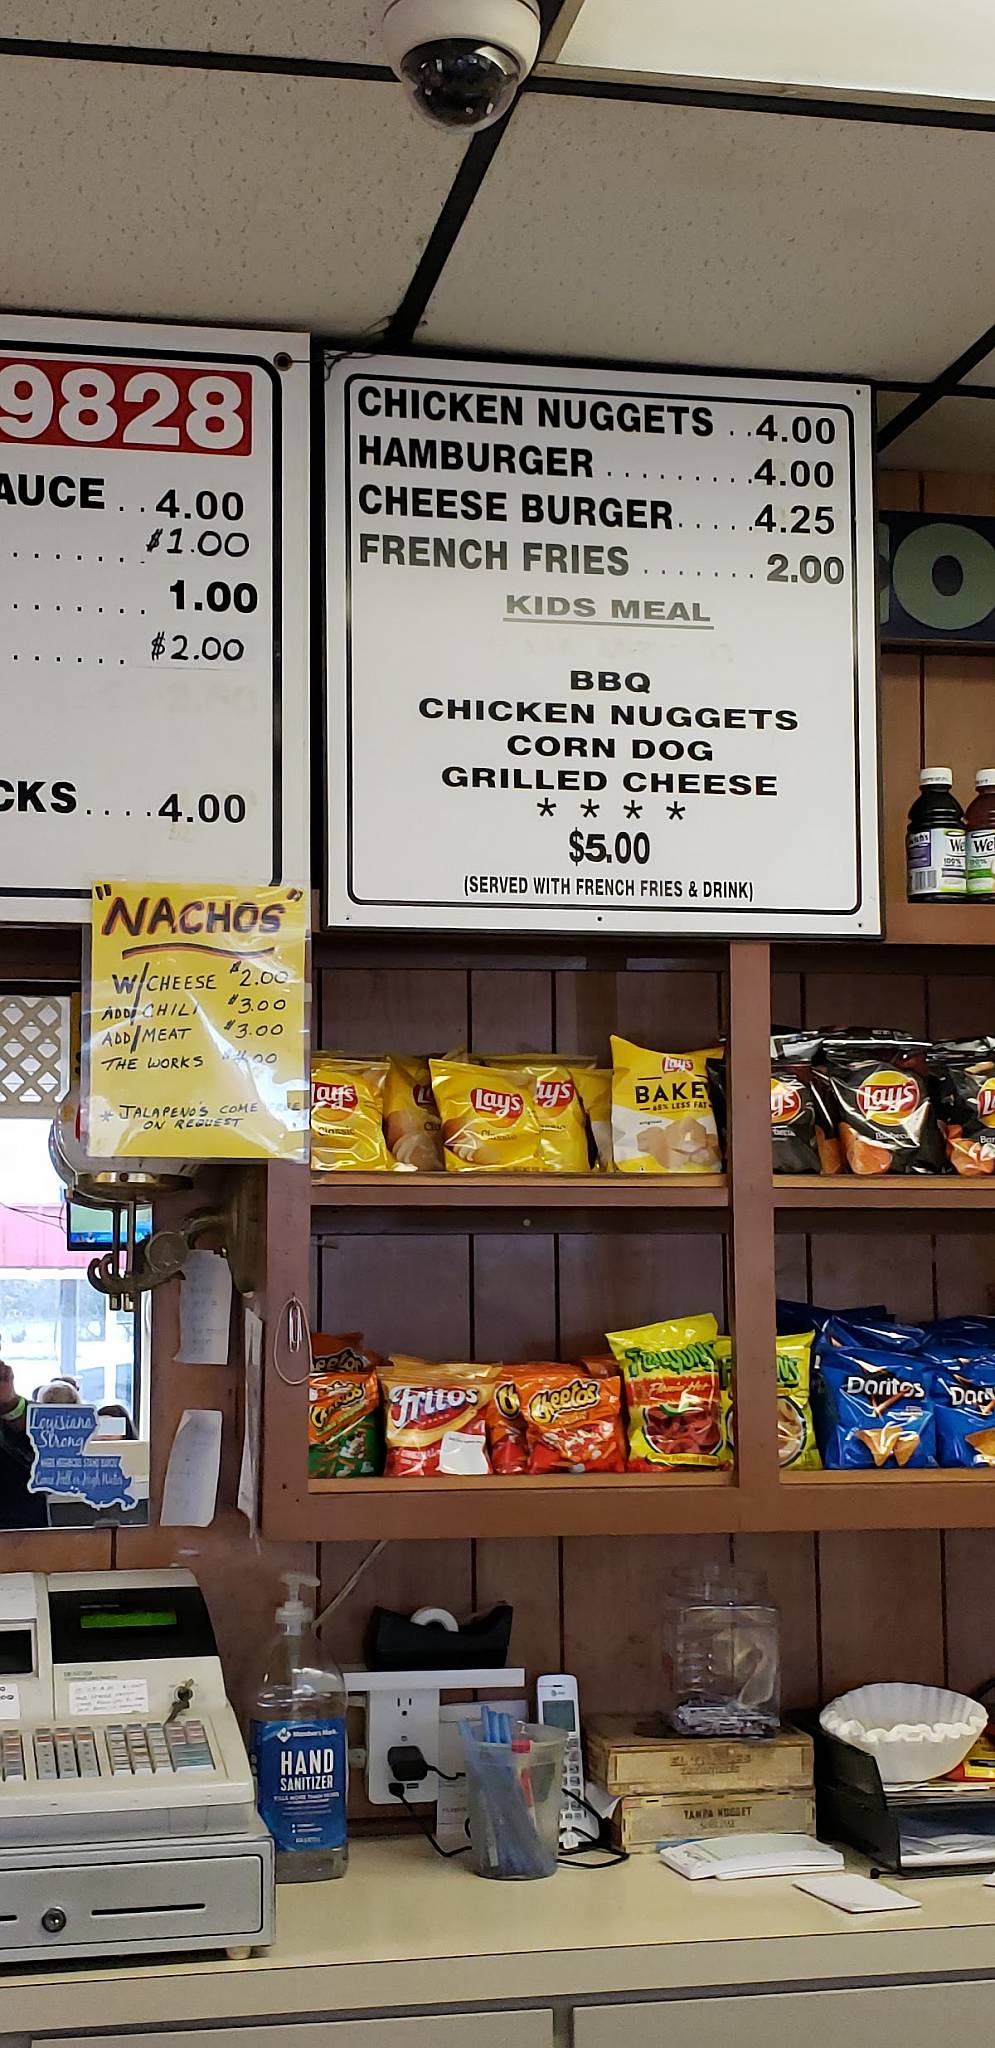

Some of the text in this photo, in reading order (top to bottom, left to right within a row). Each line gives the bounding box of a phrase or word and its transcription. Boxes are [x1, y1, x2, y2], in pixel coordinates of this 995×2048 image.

[357, 386, 836, 444] CHICKEN NUGGETS 4.00
[358, 434, 835, 488] HAMBURGER 4.00
[155, 489, 244, 521] 4.00
[358, 484, 835, 535] CHEESE BURGER 4.25
[146, 528, 250, 558] $1.00
[359, 533, 845, 585] FRENCH FRIES 2.00
[169, 579, 258, 614] 1.00
[505, 594, 712, 623] KIDS MEAL
[151, 631, 245, 661] $2.00
[569, 669, 651, 694] BBQ
[418, 697, 799, 731] CHICKEN NUGGETS
[506, 735, 714, 762] CORN DOG
[441, 766, 778, 797] GRILLED CHEESE
[158, 793, 246, 823] 4.00
[568, 827, 651, 867] $5.00
[464, 875, 754, 902] (SERVED WITH FRENCH FRIES & DRINK)
[230, 960, 289, 987] $2.00
[101, 1058, 138, 1071] THE
[147, 1055, 204, 1070] WORKS
[219, 1102, 259, 1114] COME
[671, 1101, 691, 1110] LESS
[693, 1101, 707, 1109] FAT
[143, 1117, 244, 1130] ON REQUEST
[846, 1376, 925, 1399] Doritos
[30, 1408, 94, 1431] Louisiana
[38, 1428, 84, 1456] Strong
[280, 1748, 334, 1776] HAND
[280, 1775, 334, 1792] SANITIZER
